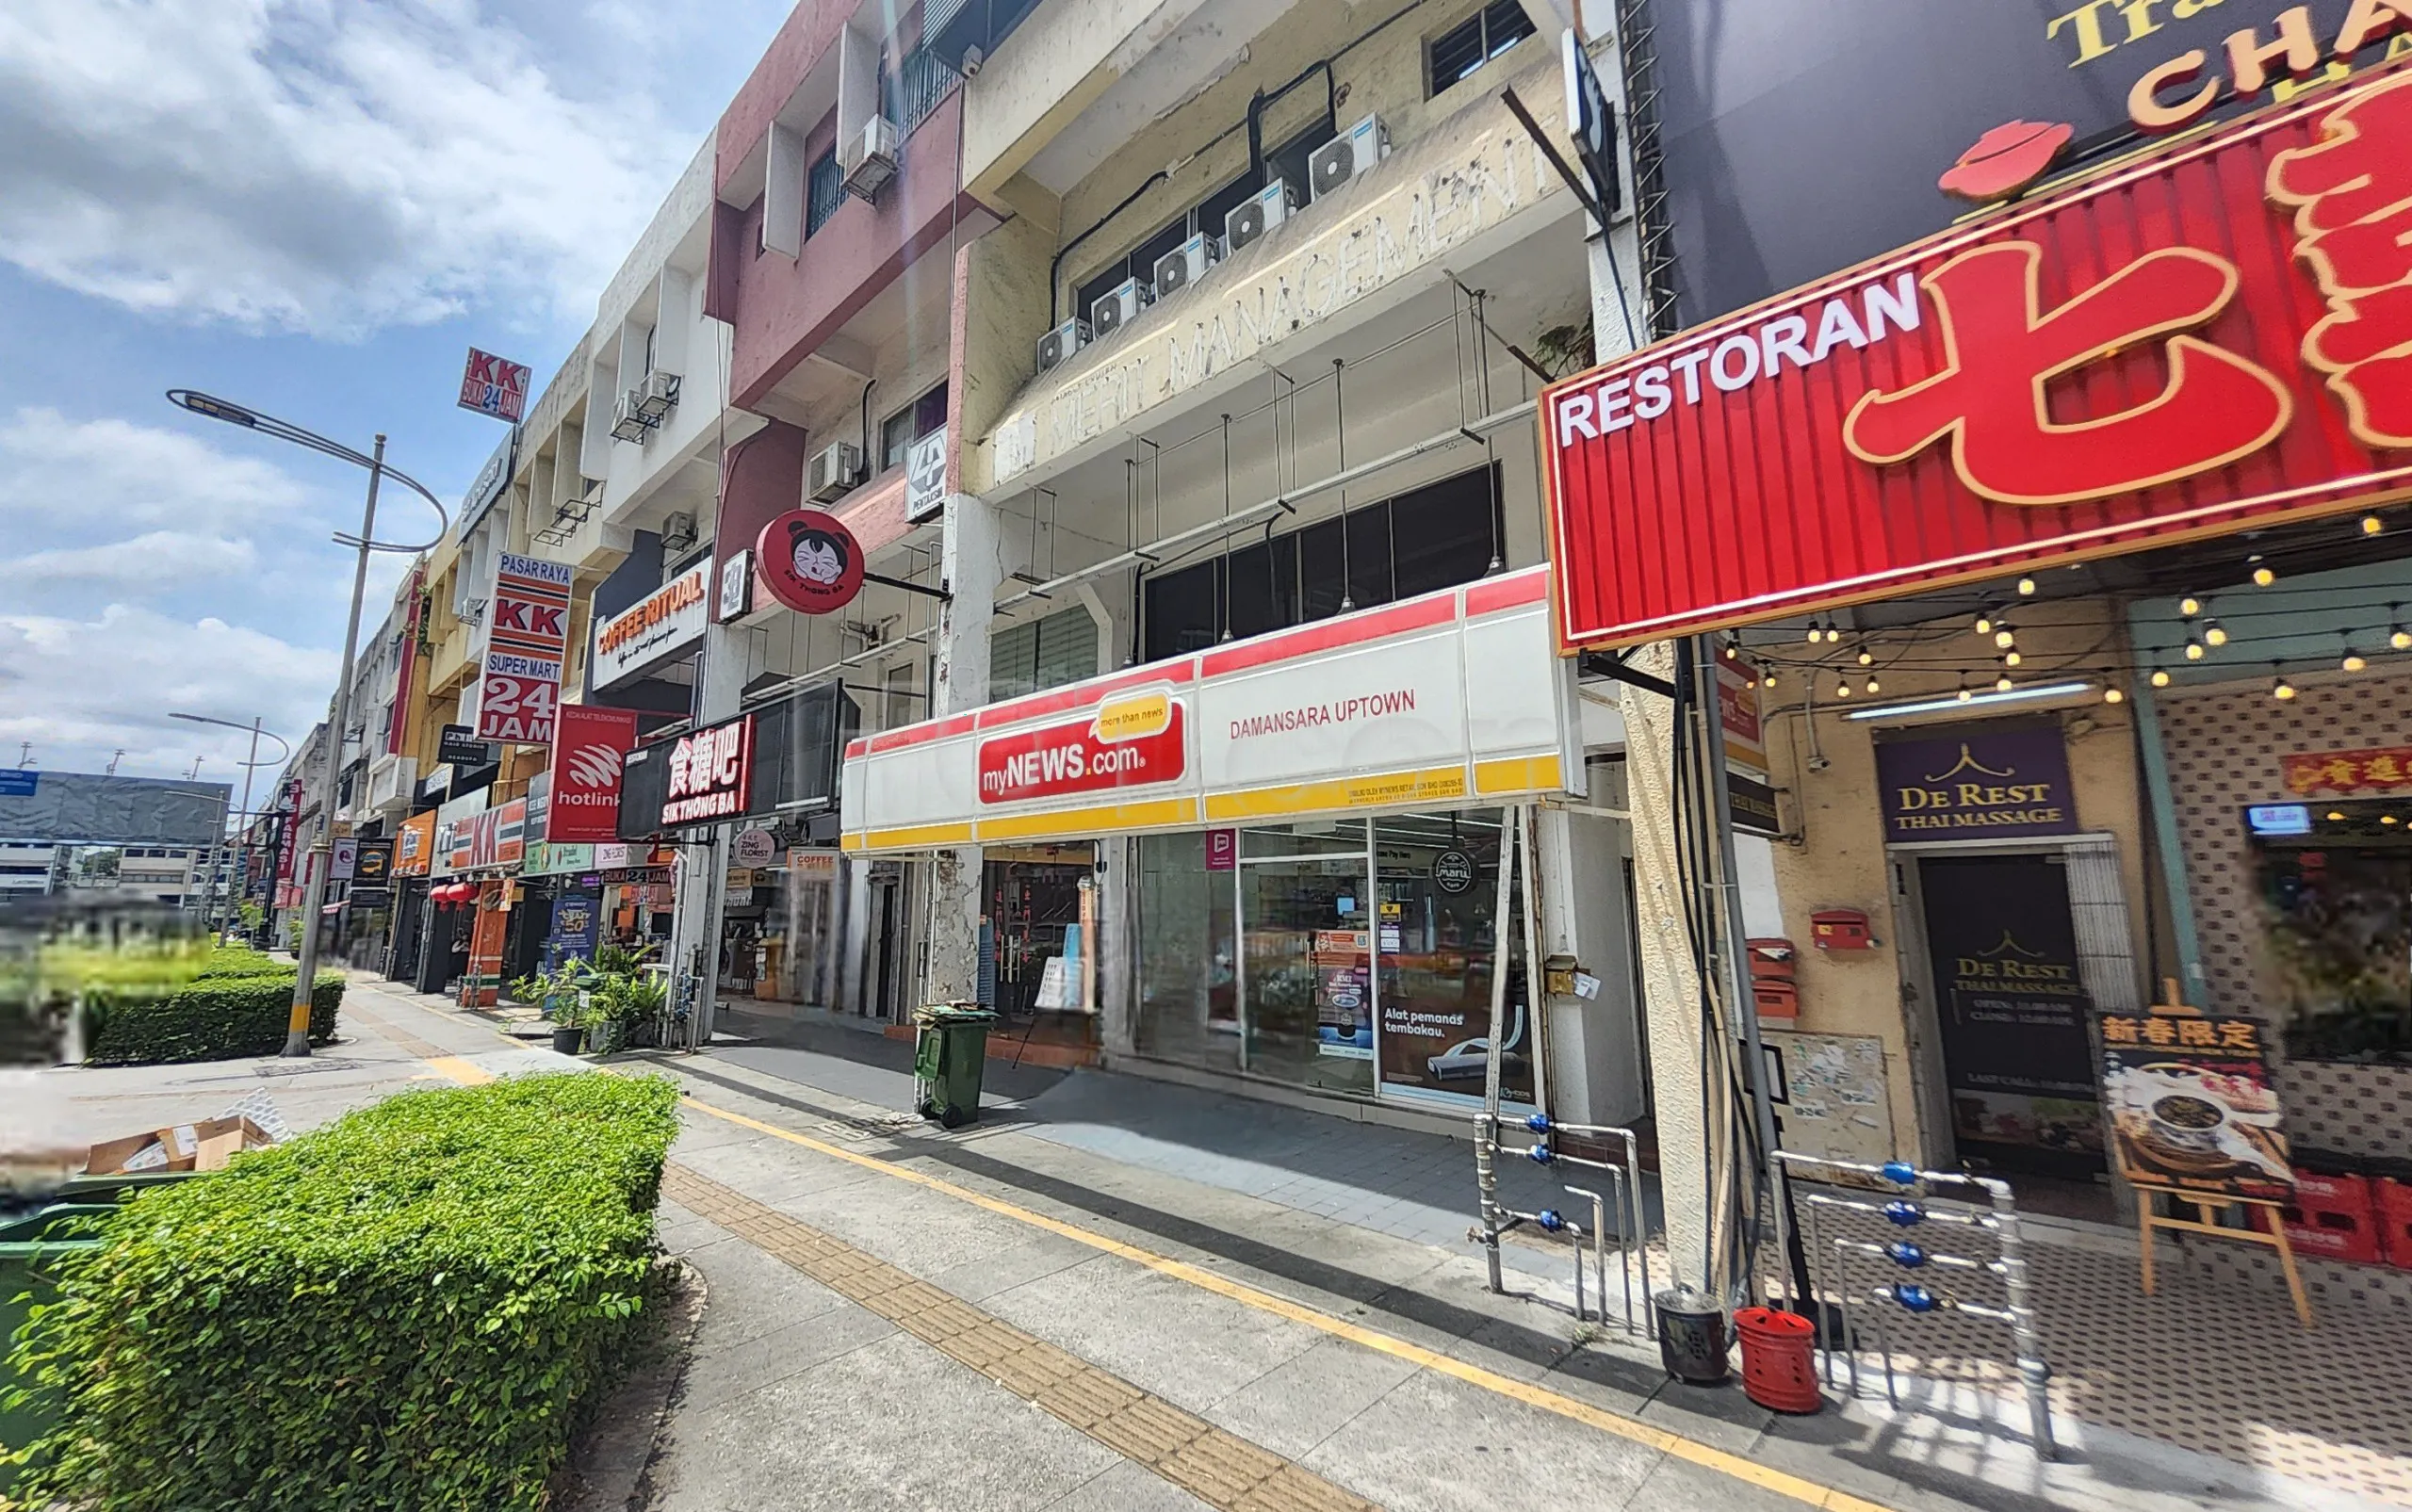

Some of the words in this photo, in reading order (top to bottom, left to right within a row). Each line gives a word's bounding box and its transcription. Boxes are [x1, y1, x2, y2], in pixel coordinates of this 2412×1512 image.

[470, 350, 523, 393] KK
[1559, 272, 1920, 447] RESTORAN
[481, 384, 501, 412] 24
[499, 389, 522, 418] JAM
[1050, 355, 1150, 456] MERIT
[499, 554, 538, 578] PASAR
[539, 562, 570, 584] RAYA
[494, 598, 565, 637] KK
[598, 606, 646, 656] COFFEE
[643, 571, 705, 626] RITUAL
[488, 654, 528, 675] SUPER
[529, 660, 561, 680] MART
[483, 677, 556, 720] 24
[481, 714, 552, 742] JAM
[1100, 717, 1120, 728] more
[1122, 711, 1140, 723] than
[1141, 707, 1164, 721] news
[1230, 703, 1330, 740] DAMANSARA
[1334, 688, 1415, 723] UPTOWN
[661, 802, 678, 824] SIK
[678, 793, 718, 821] THONG
[717, 789, 735, 815] BA
[1955, 783, 2050, 807] REST
[1894, 813, 1950, 830] THAI
[1952, 807, 2064, 827] MASSAGE
[278, 816, 293, 871] FARMASI
[470, 807, 501, 866] KK
[741, 840, 759, 849] ZING
[797, 855, 834, 864] COFFEE
[604, 870, 626, 883] BUKA
[627, 870, 647, 883] 24
[649, 870, 669, 883] JAM
[2000, 959, 2072, 980] REST
[1384, 1007, 1410, 1021] Alat
[1410, 1011, 1464, 1026] pemanas
[1384, 1021, 1446, 1038] tembakau.
